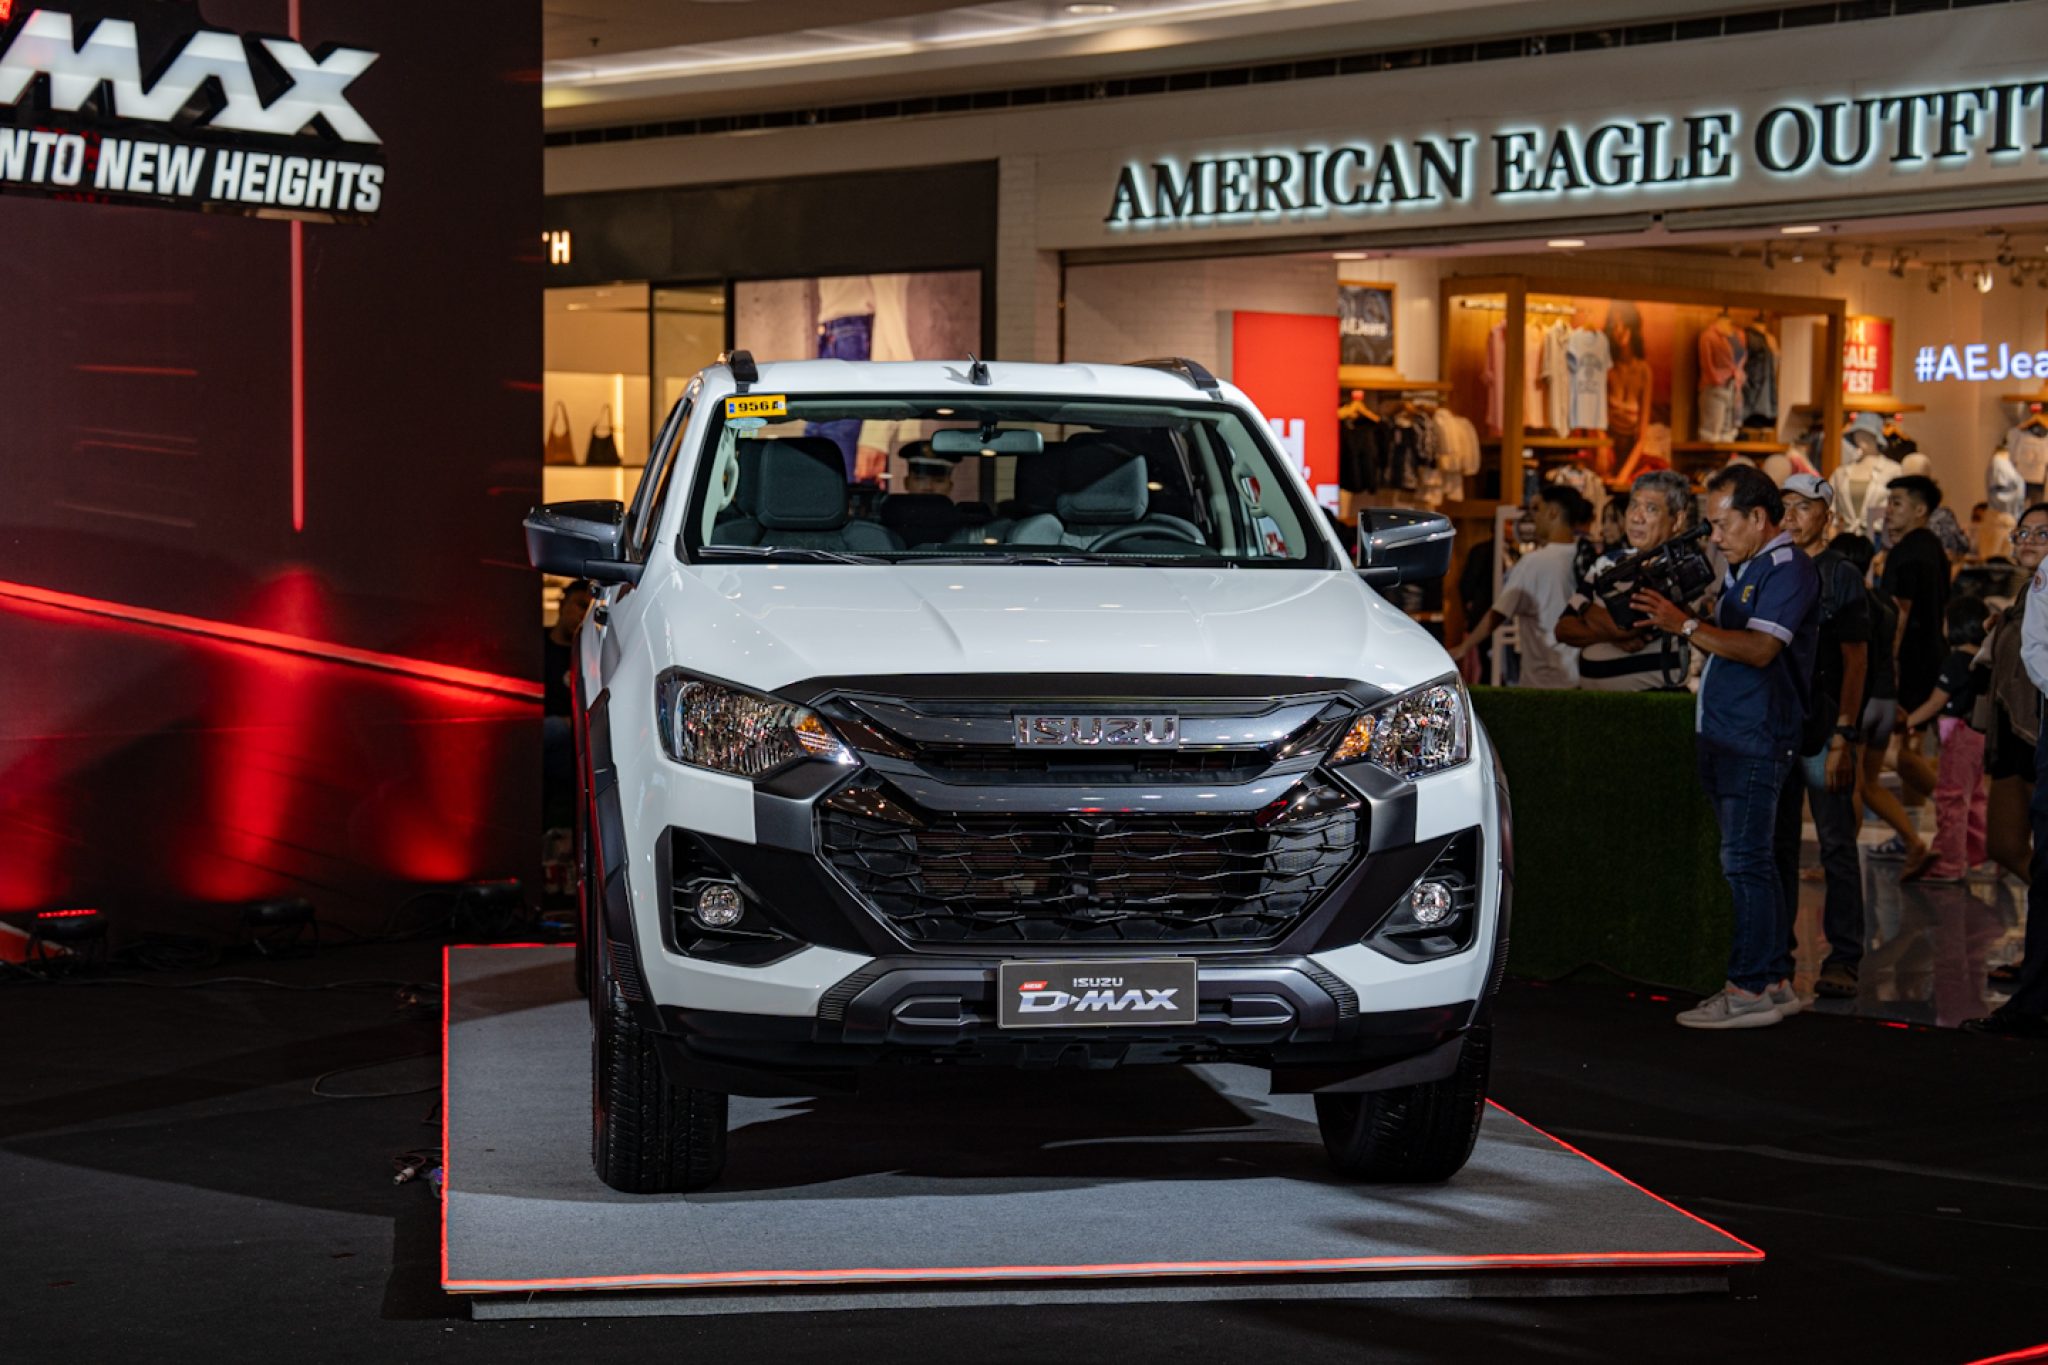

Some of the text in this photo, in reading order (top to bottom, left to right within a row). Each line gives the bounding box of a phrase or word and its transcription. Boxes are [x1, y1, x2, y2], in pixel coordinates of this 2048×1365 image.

[94, 137, 206, 197] NEW
[210, 150, 385, 213] HEIGHTS
[1104, 138, 1473, 222] AMERICAN
[1490, 114, 1733, 195] EAGLE
[541, 231, 570, 264] H
[1018, 717, 1175, 745] ISUZU
[1072, 977, 1124, 988] ISUZU
